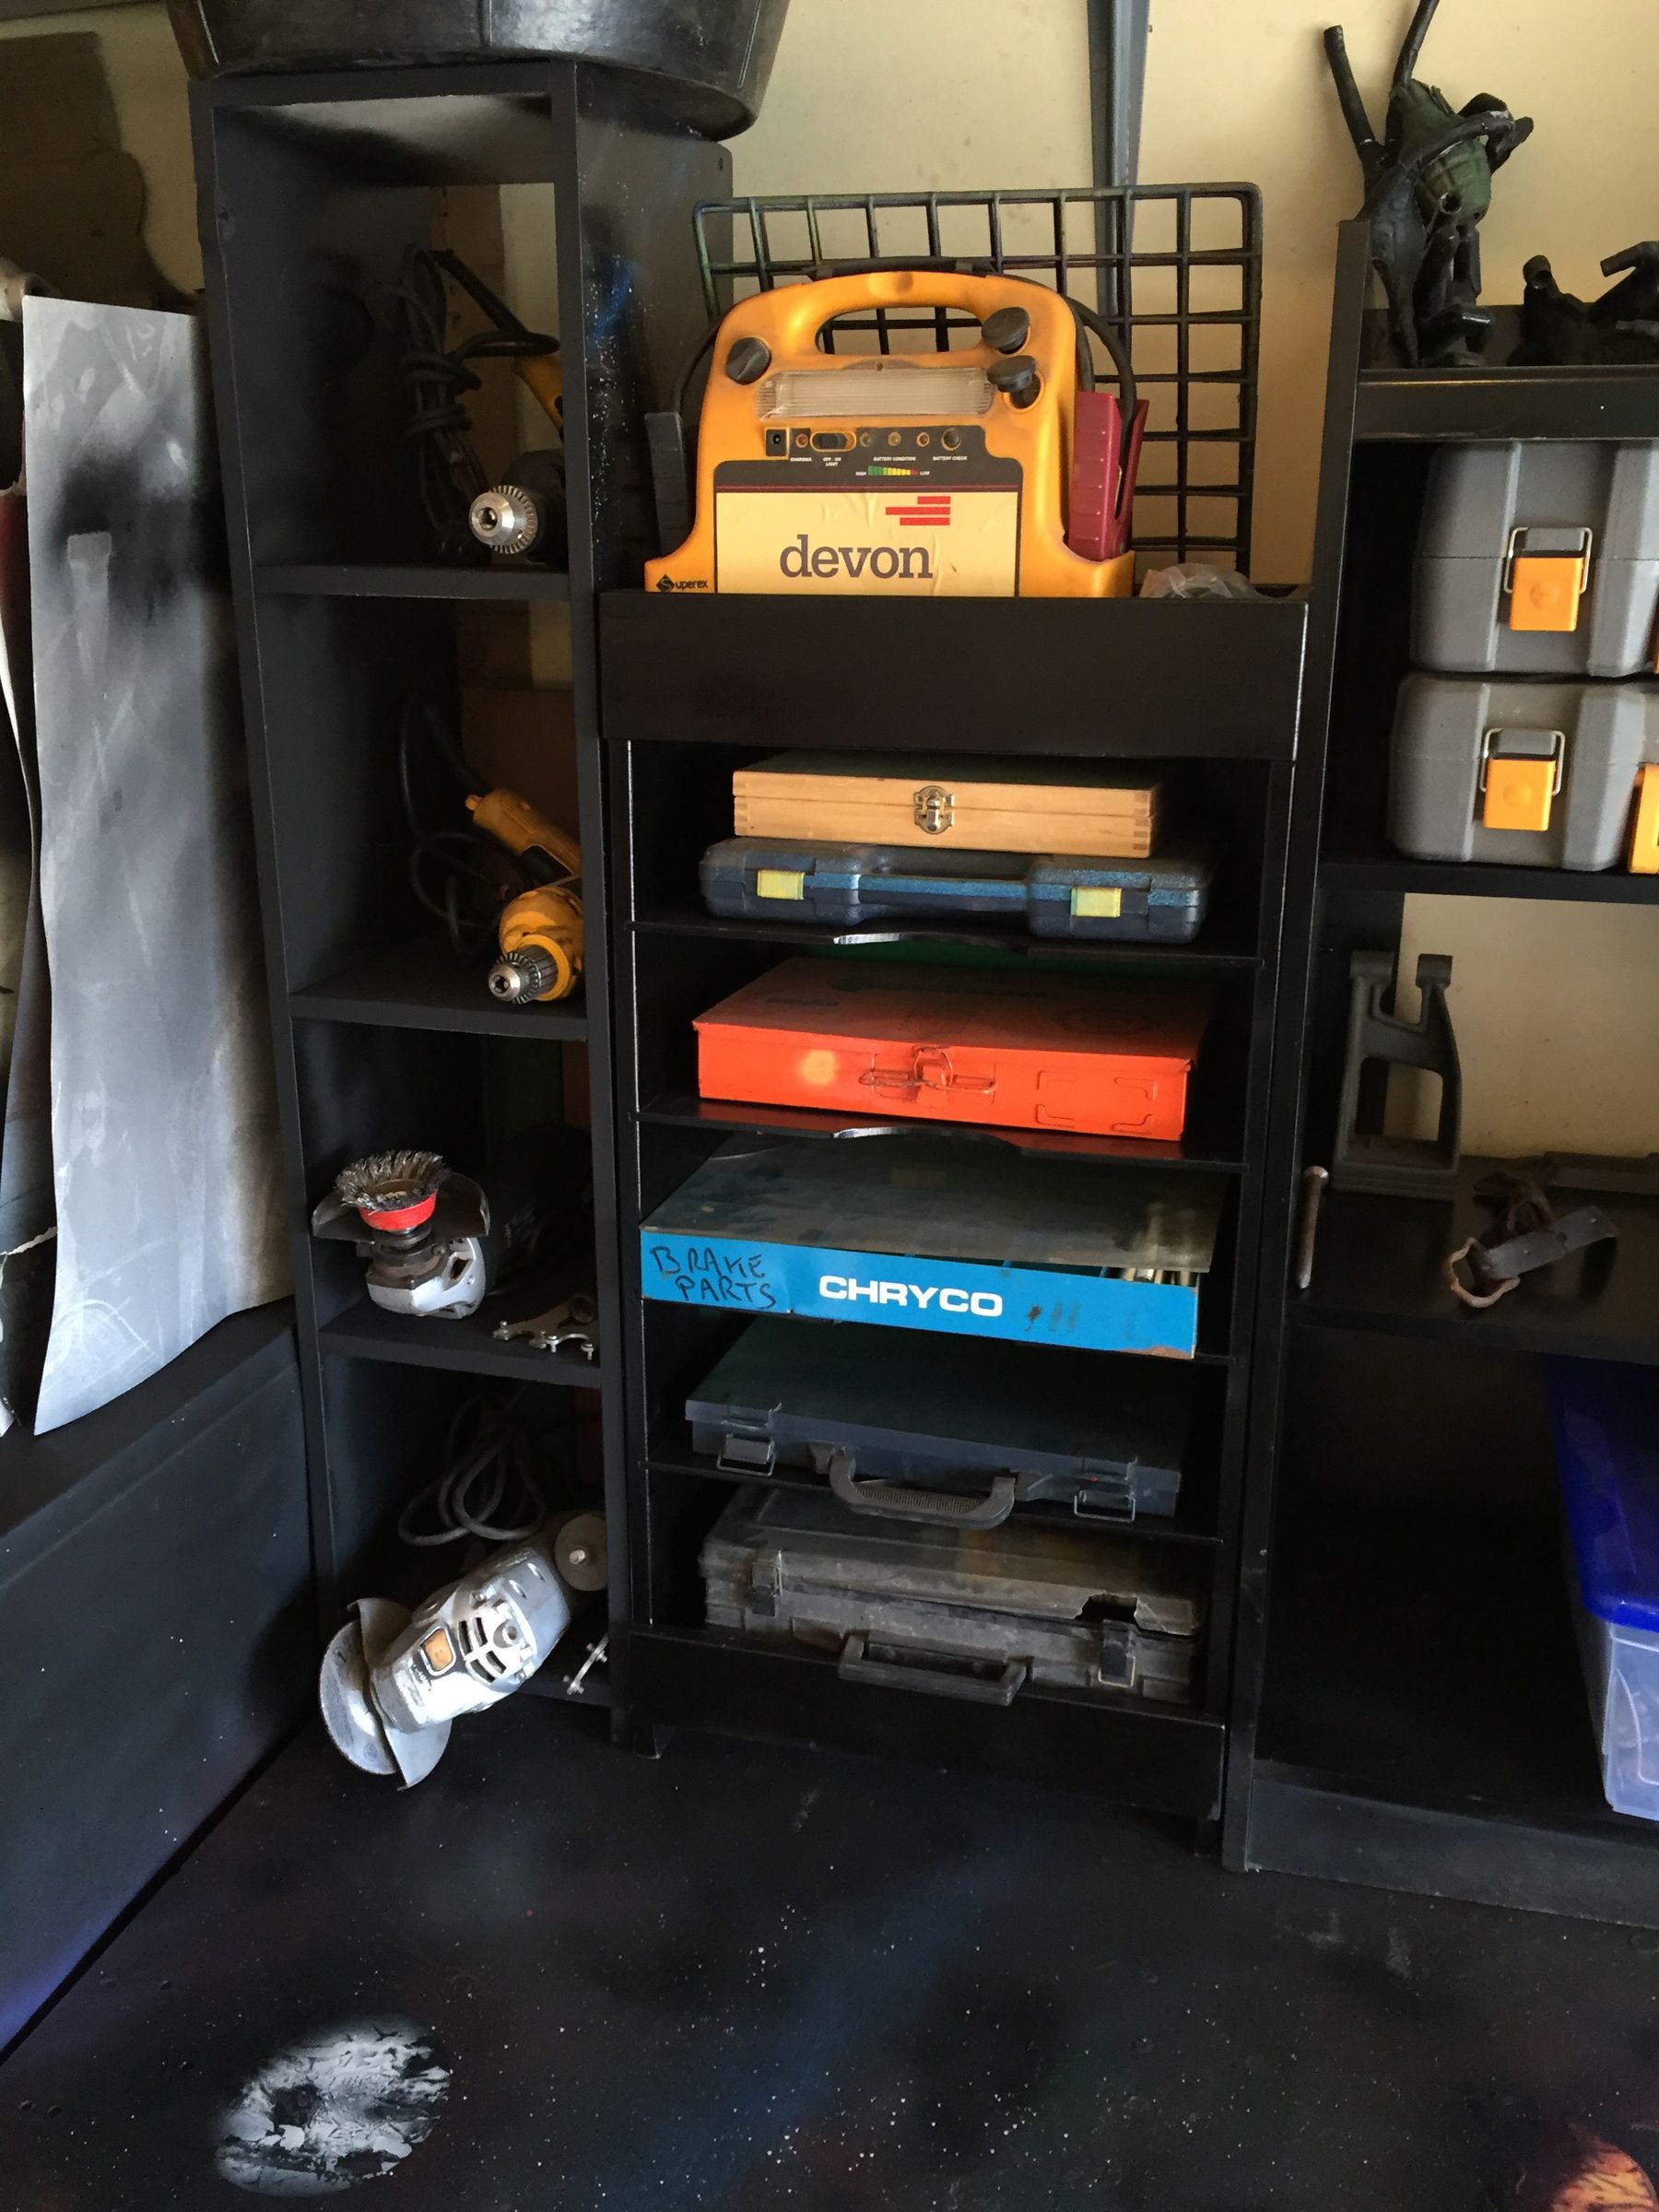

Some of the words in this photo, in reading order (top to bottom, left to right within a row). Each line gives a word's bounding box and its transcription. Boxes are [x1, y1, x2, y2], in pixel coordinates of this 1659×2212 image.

[780, 534, 934, 579] devon
[650, 1246, 766, 1278] BRAKE
[675, 1275, 776, 1310] PARTS
[818, 1275, 1003, 1317] CHRYCO
